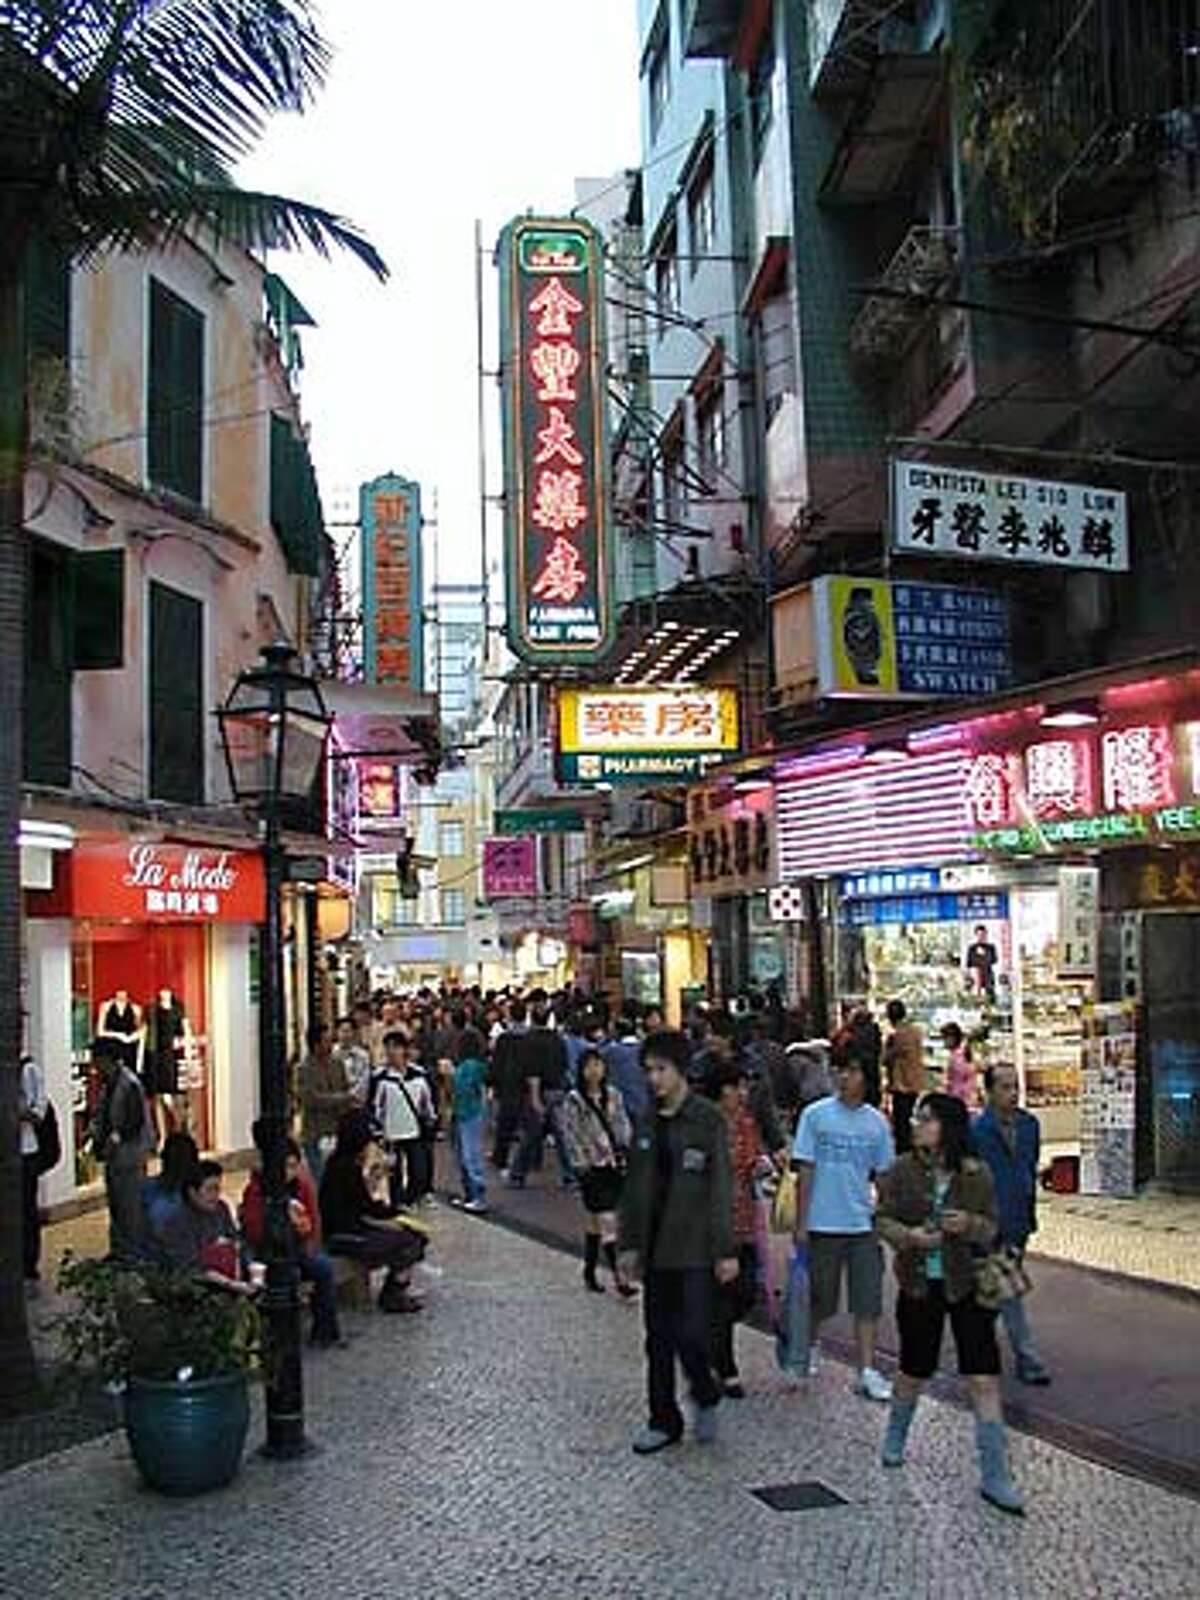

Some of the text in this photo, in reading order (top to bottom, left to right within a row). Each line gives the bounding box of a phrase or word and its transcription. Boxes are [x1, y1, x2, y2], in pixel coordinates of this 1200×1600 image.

[908, 468, 986, 494] DENTISTA
[997, 482, 1027, 500] LEI
[910, 498, 1116, 564] 牙醫李兆麟
[912, 671, 998, 695] SWATCH
[583, 701, 715, 736] 藥房
[604, 757, 698, 776] PHARMACY
[124, 845, 239, 890] La Mode
